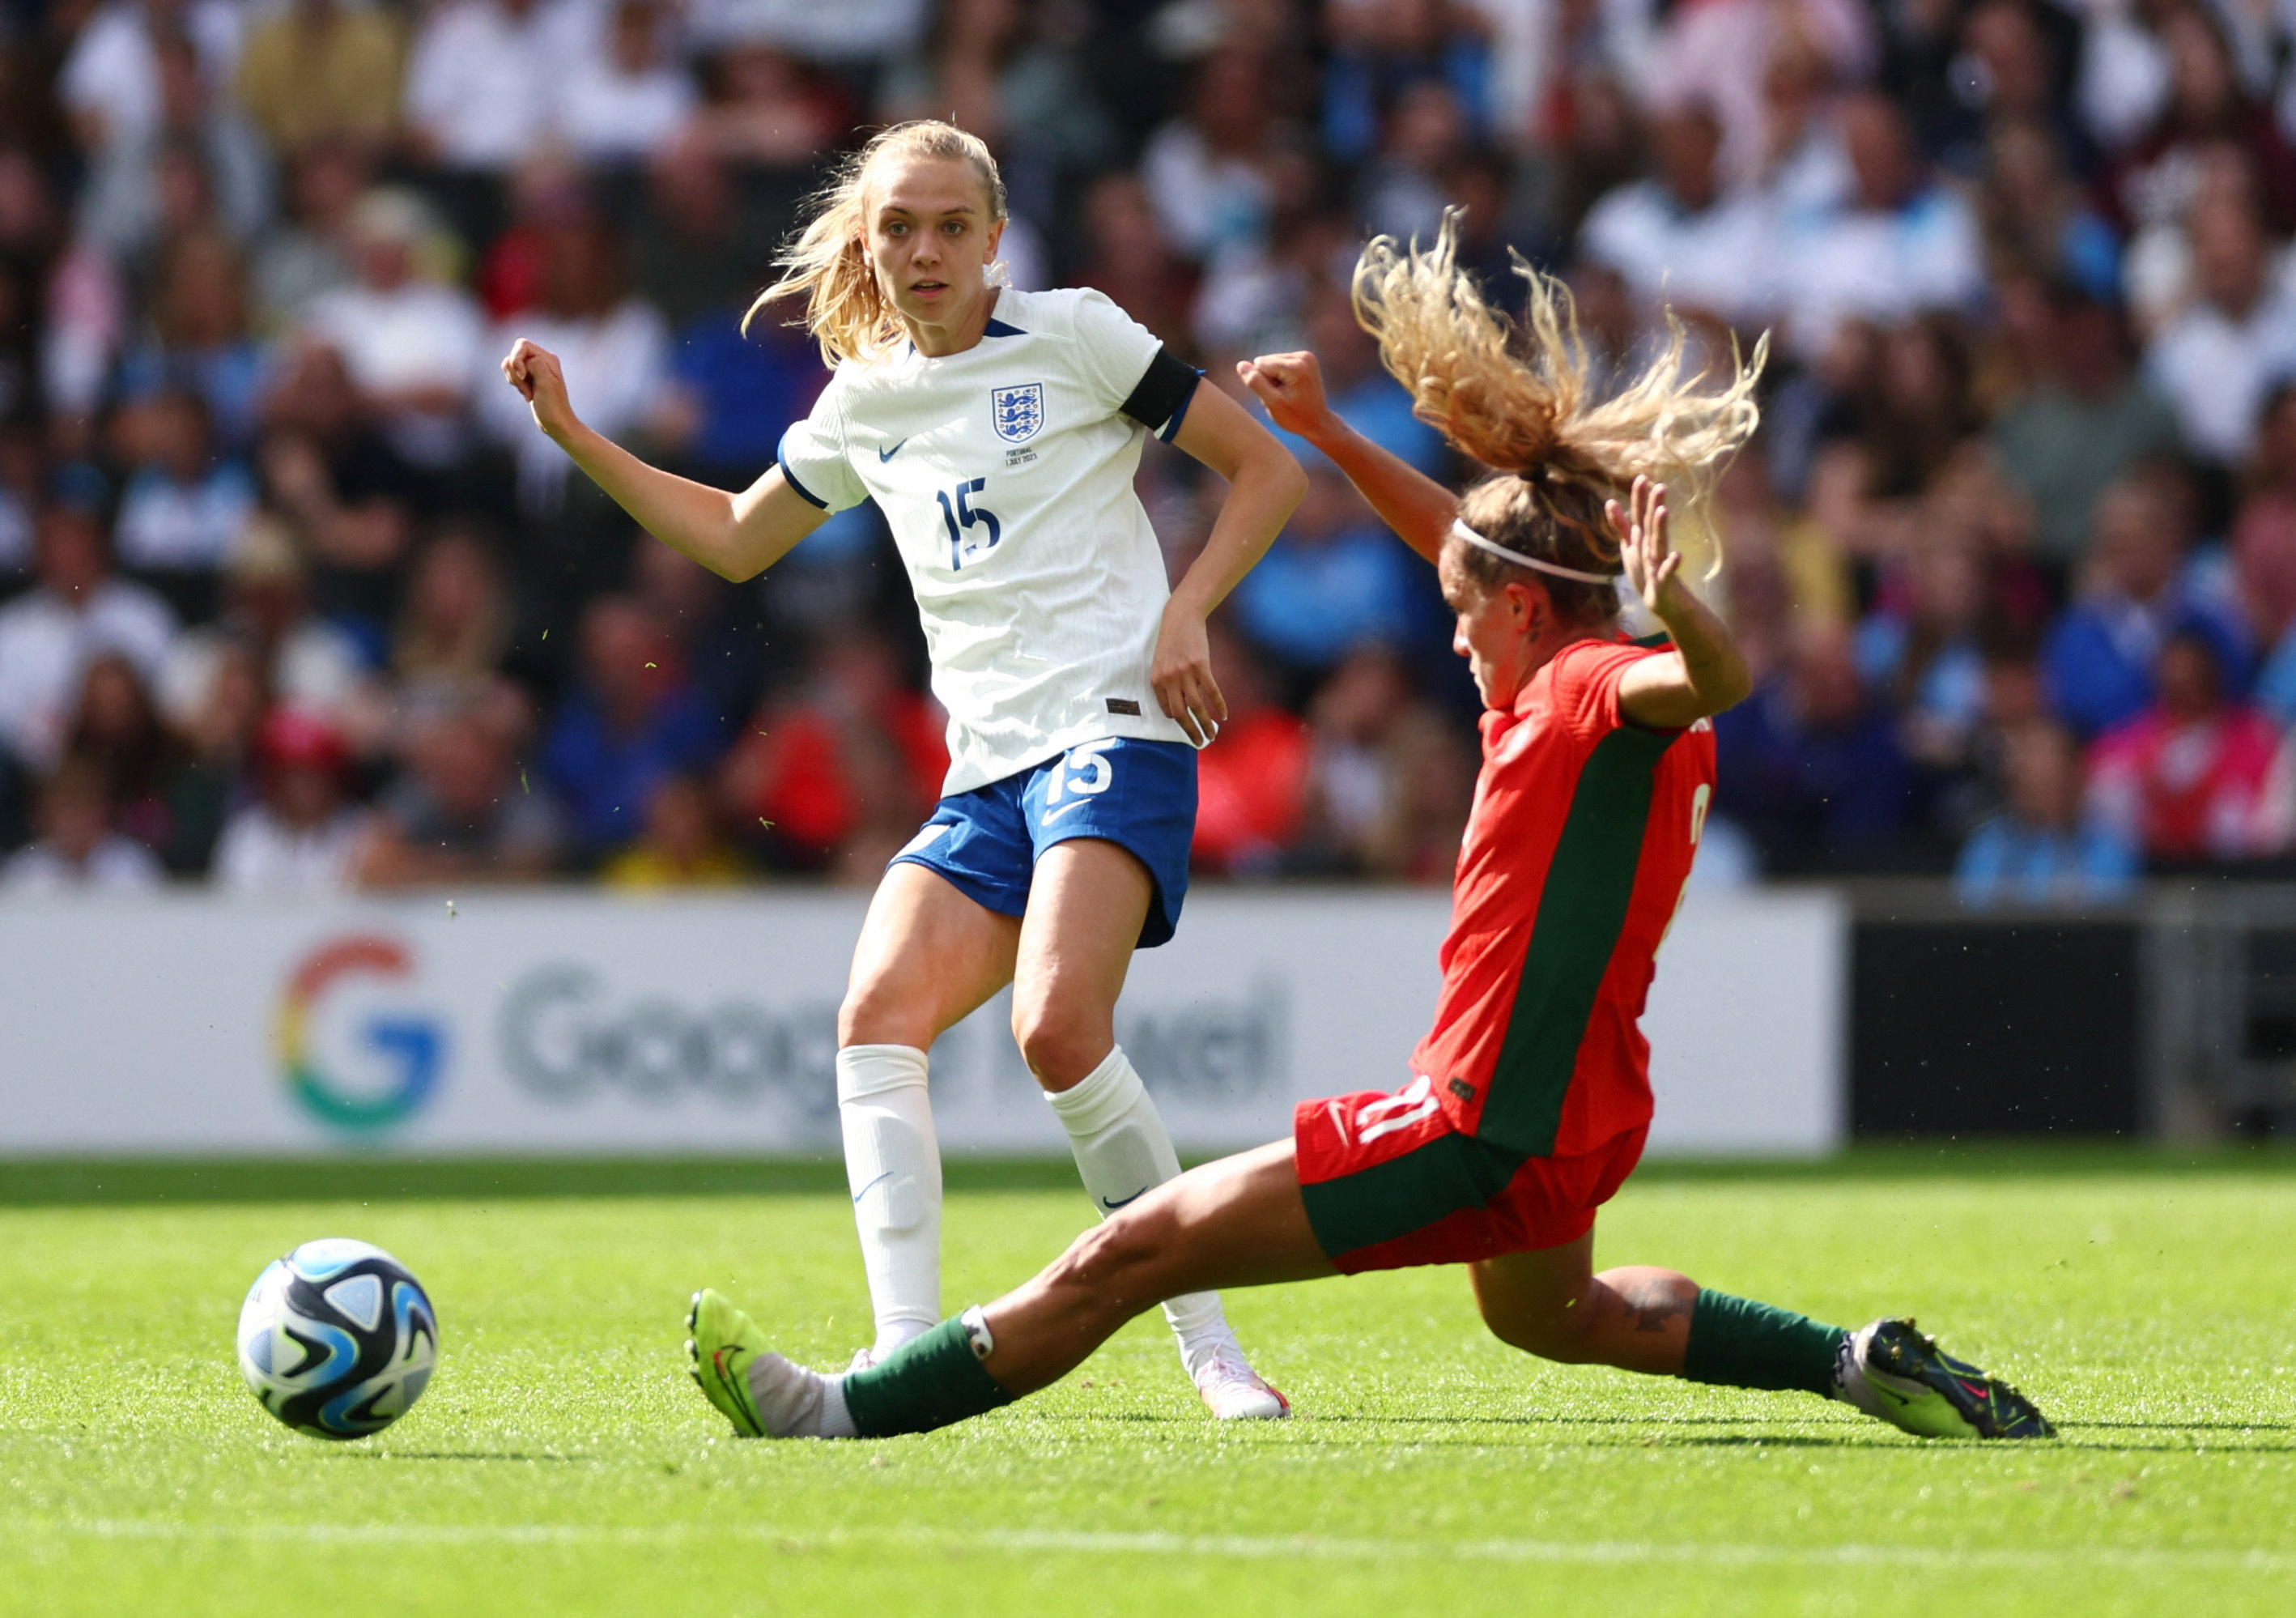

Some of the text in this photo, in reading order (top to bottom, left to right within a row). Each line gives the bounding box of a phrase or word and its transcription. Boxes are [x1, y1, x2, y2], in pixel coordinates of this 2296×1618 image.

[1006, 446, 1032, 457] PORTUGAL
[936, 477, 1001, 571] 15
[266, 931, 452, 1134] G
[495, 956, 961, 1135] Goog
